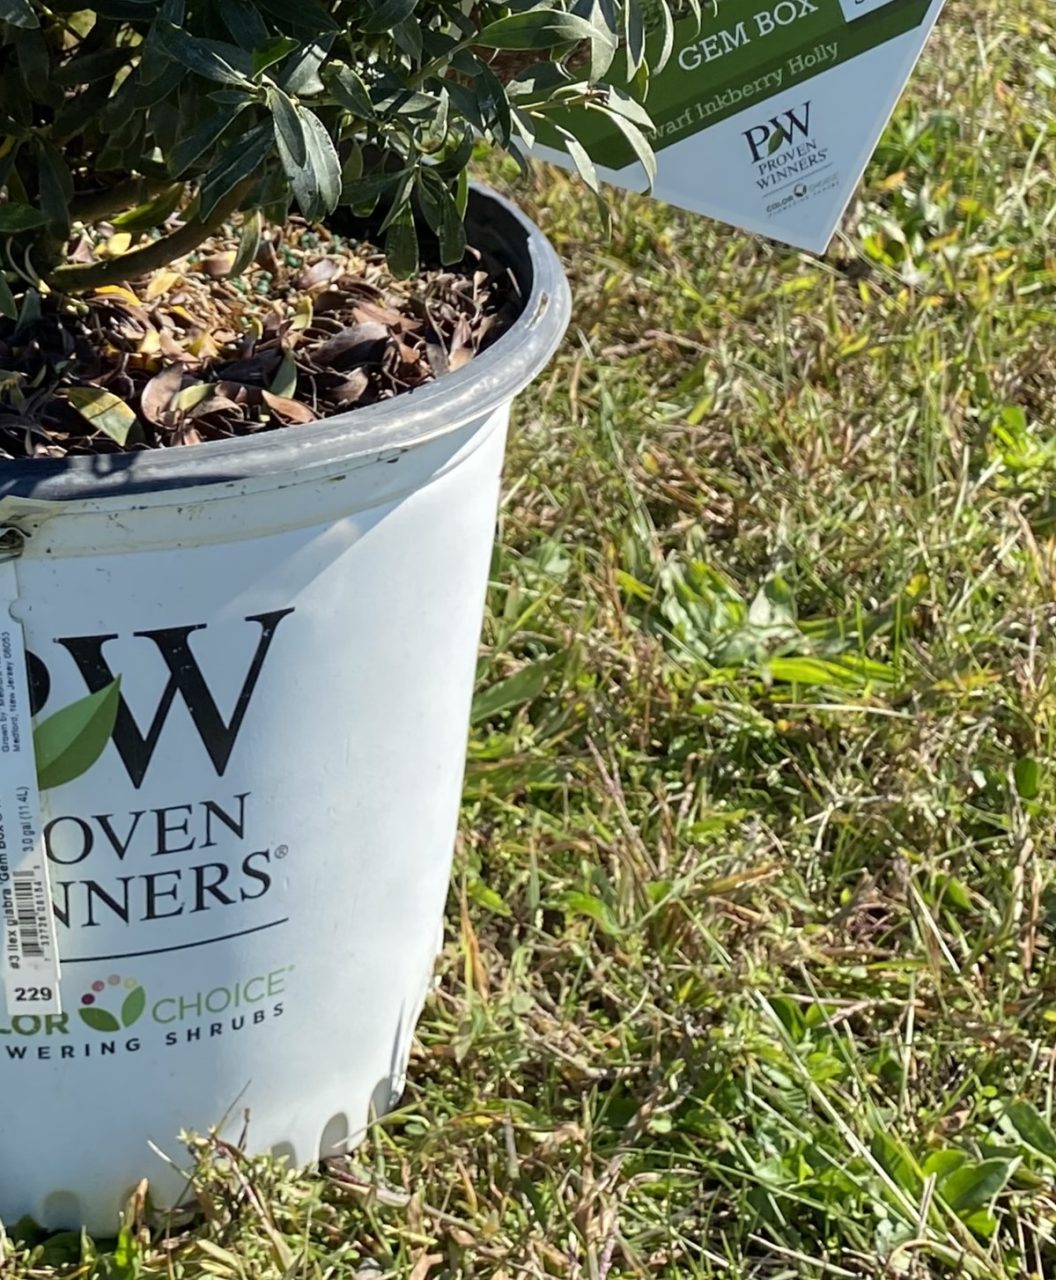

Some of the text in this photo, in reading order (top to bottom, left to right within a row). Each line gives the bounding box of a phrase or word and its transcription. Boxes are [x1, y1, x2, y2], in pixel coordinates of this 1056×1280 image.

[678, 22, 751, 71] GEM
[644, 41, 839, 142] warf Inkberry Holly
[741, 100, 812, 164] PW
[757, 138, 818, 176] PROVEN
[14, 986, 53, 1002] 229
[165, 1002, 286, 1047] SHRUBS
